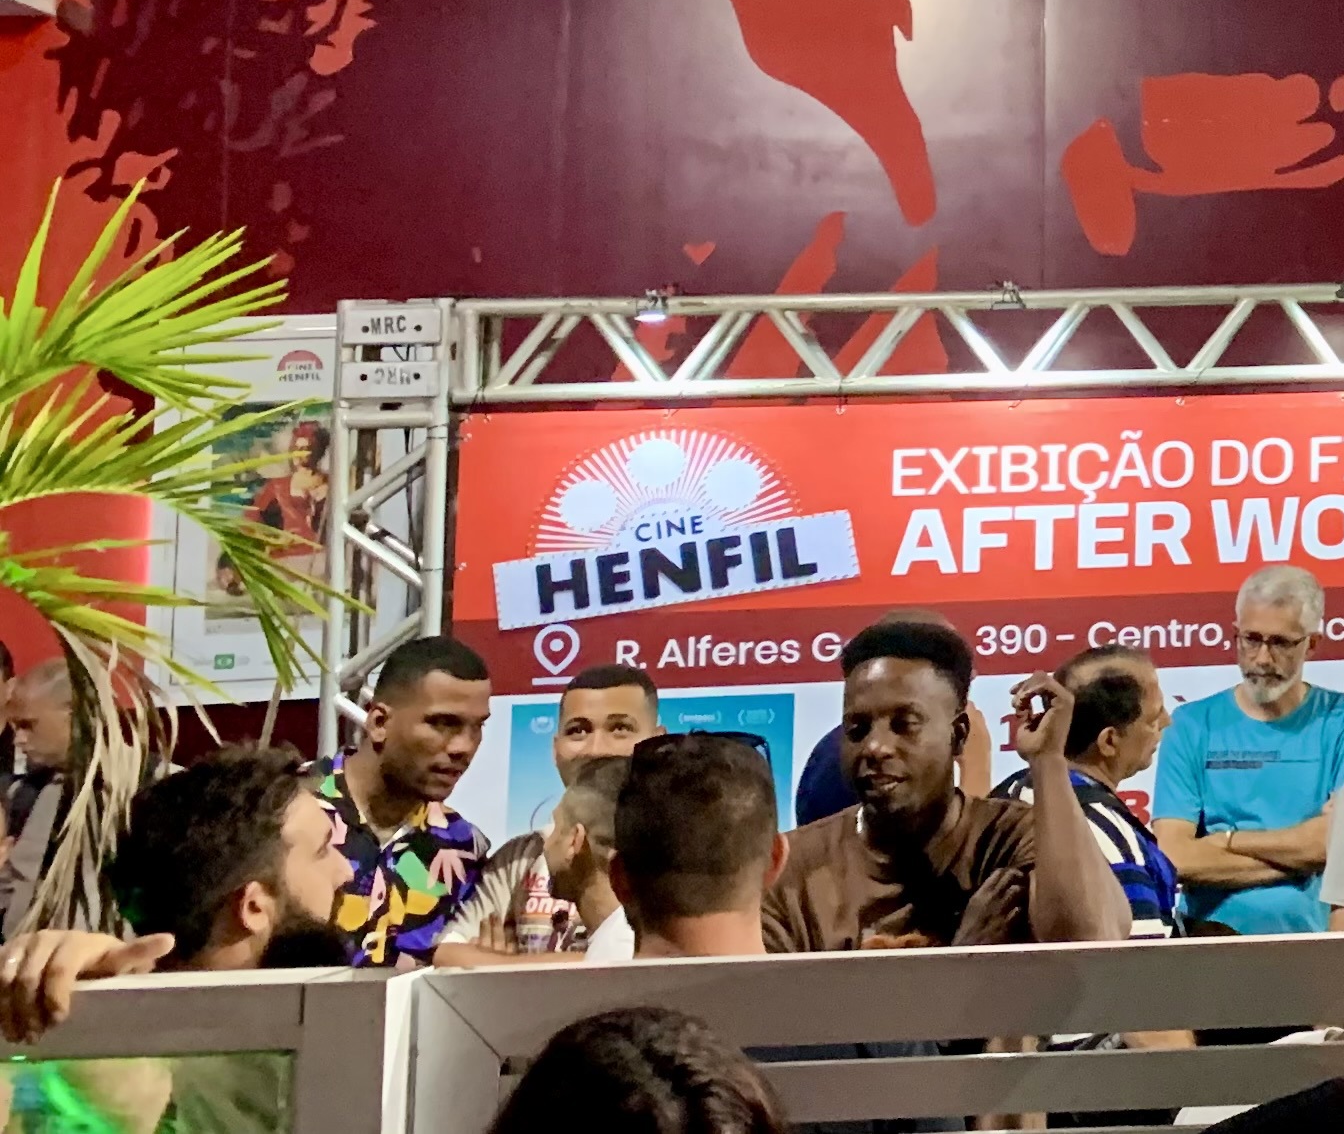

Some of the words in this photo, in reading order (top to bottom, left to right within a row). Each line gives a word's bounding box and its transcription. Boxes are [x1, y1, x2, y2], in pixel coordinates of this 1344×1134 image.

[370, 315, 407, 335] MRC
[891, 429, 1195, 503] EXIBIÇÃO
[1211, 437, 1294, 487] DO
[634, 514, 705, 543] CINE
[891, 500, 1193, 576] AFTER
[534, 526, 819, 615] HENFIL
[615, 639, 648, 670] R.
[656, 634, 801, 669] Alferes
[975, 623, 1049, 657] 390
[1087, 619, 1232, 652] Centro,
